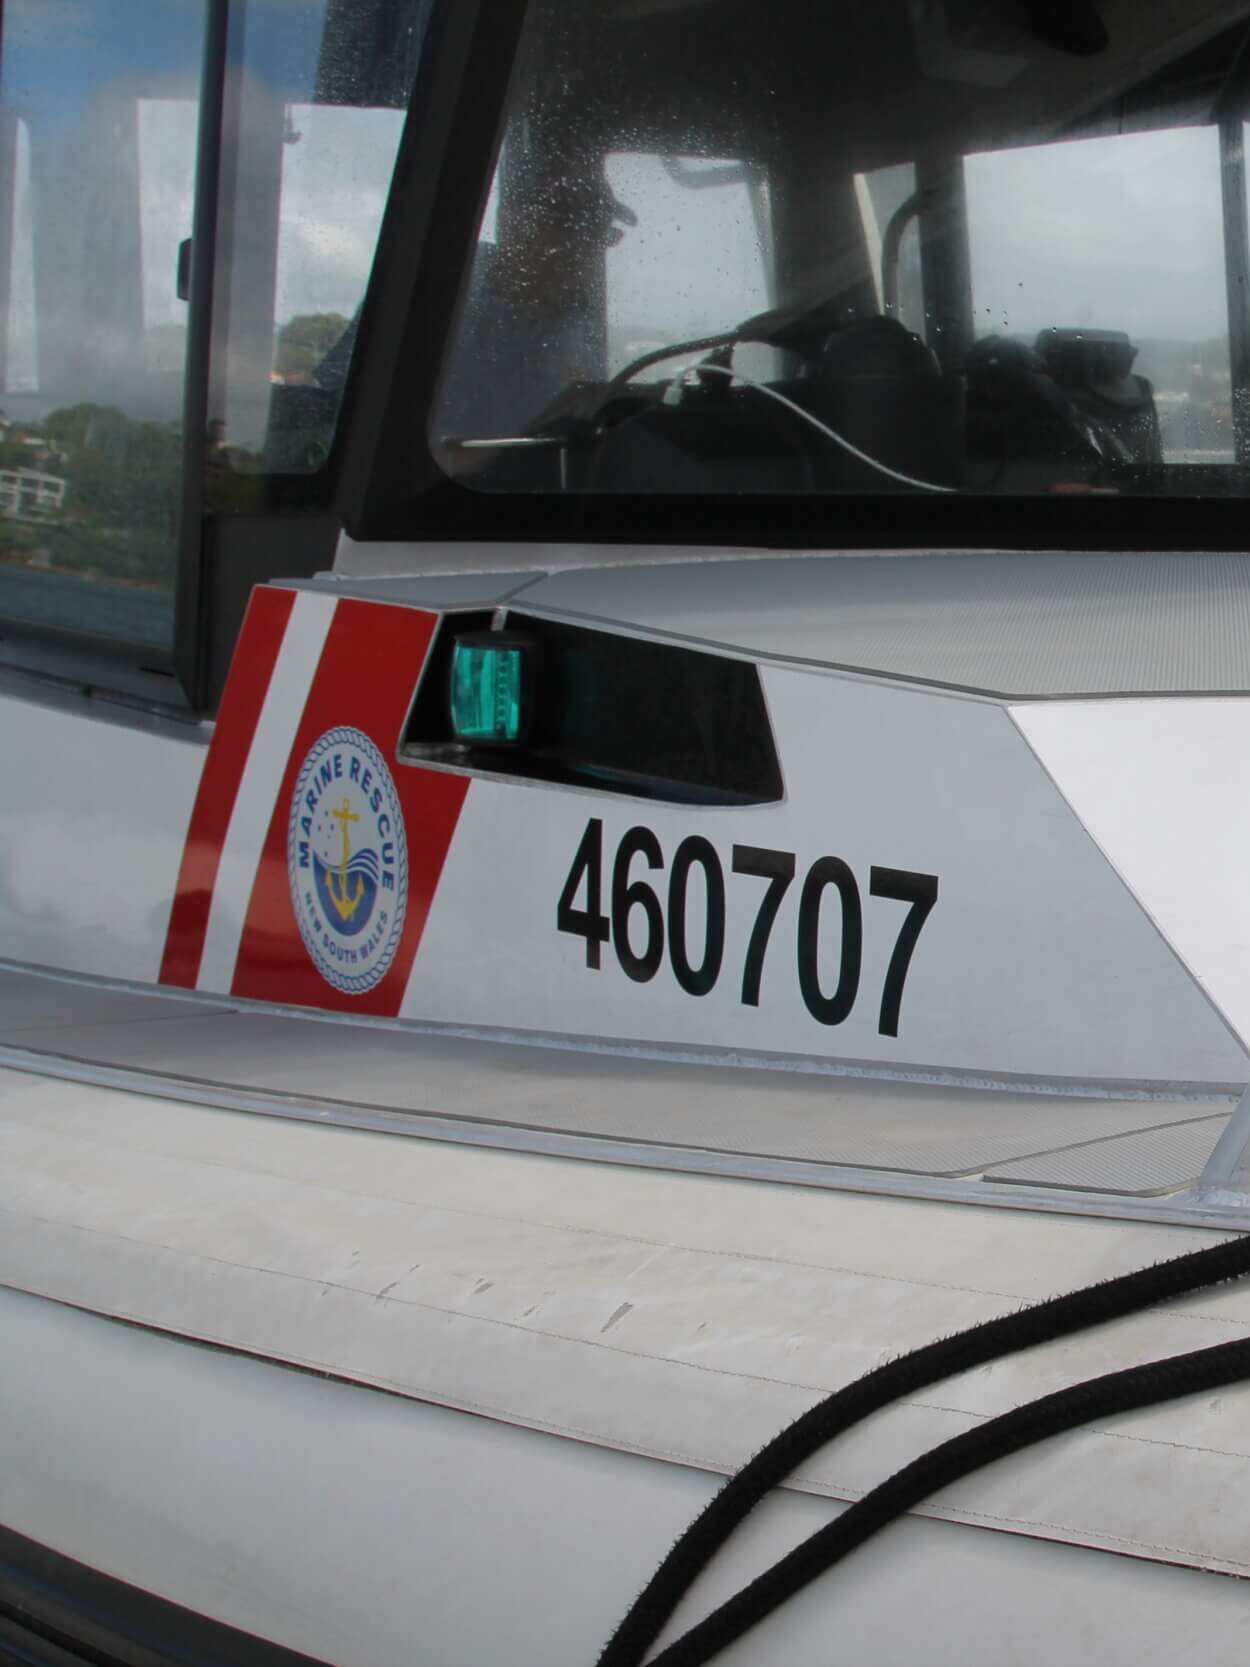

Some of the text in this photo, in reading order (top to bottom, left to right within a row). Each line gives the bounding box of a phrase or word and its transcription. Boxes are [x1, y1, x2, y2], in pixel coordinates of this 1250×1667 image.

[299, 754, 395, 891] MARINE RESCUE
[323, 933, 358, 964] SOUTH
[359, 909, 388, 960] WALES
[557, 817, 939, 1037] 460707
